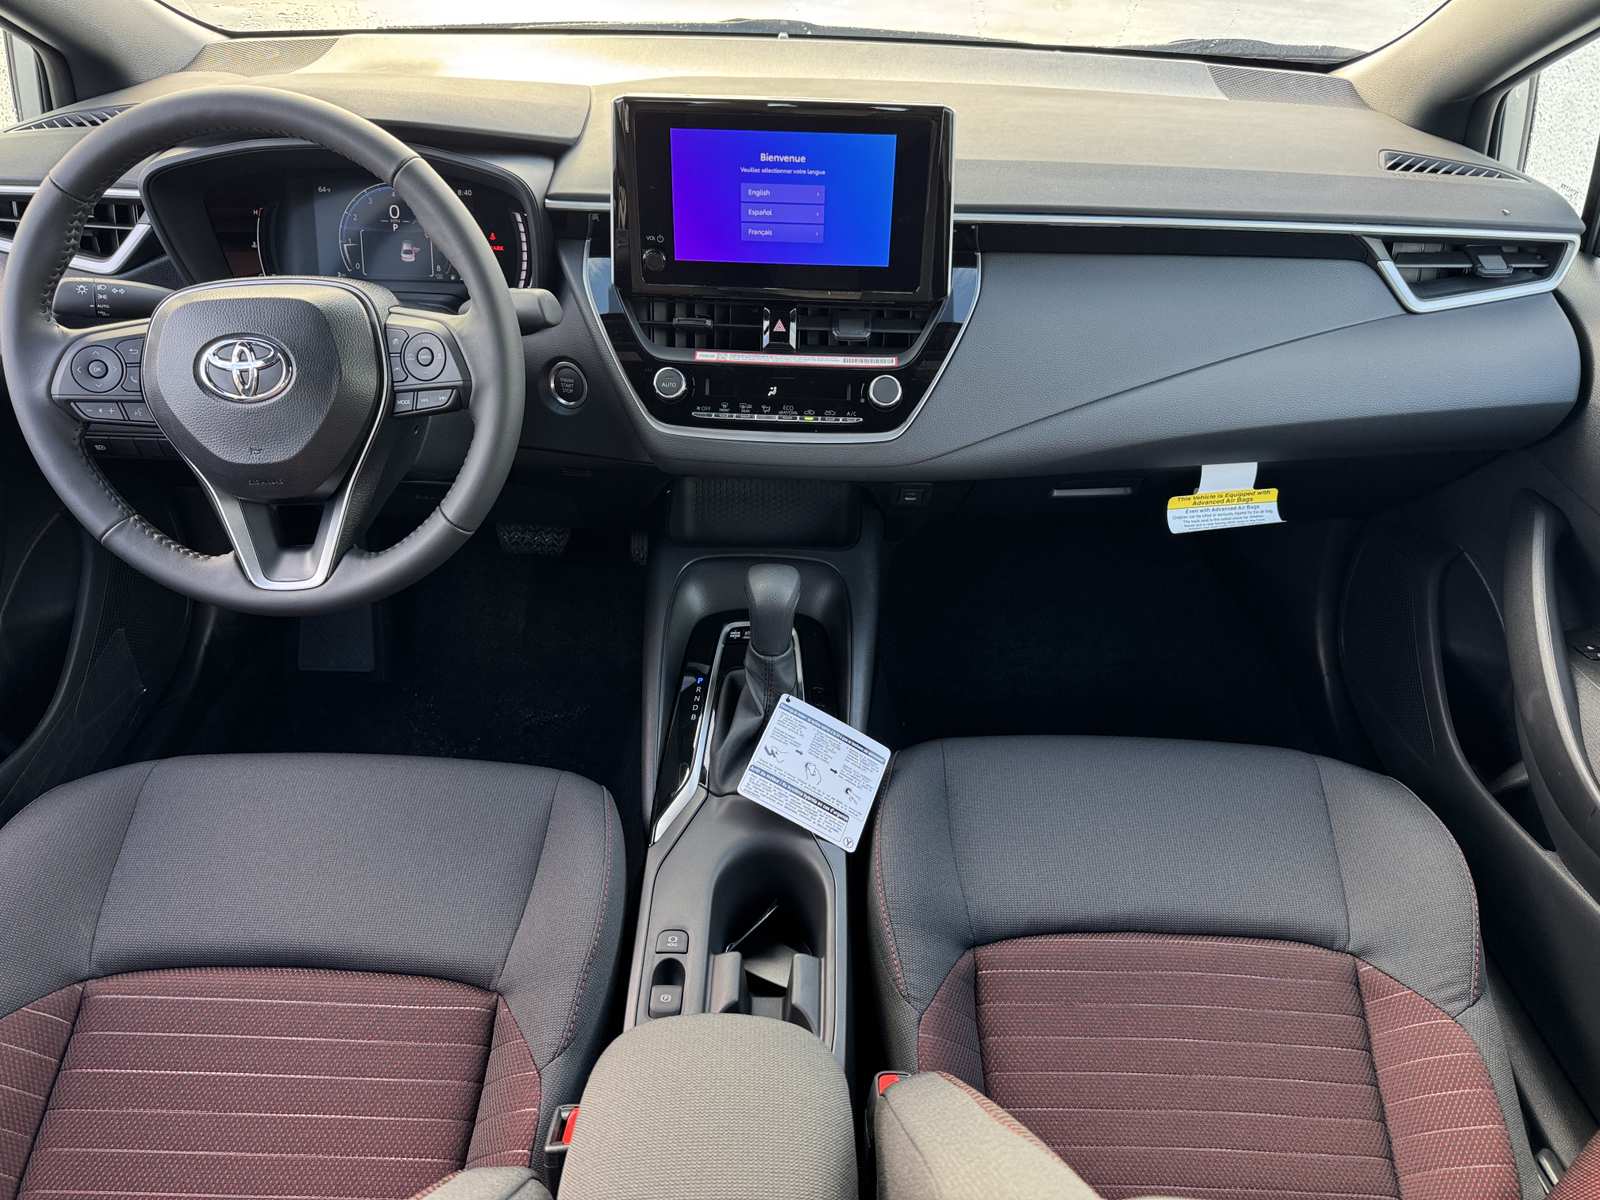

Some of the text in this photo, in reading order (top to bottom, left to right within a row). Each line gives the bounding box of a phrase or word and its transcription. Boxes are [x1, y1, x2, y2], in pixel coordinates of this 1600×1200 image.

[760, 152, 806, 163] Bienvenue
[748, 189, 770, 197] English
[392, 224, 398, 232] P
